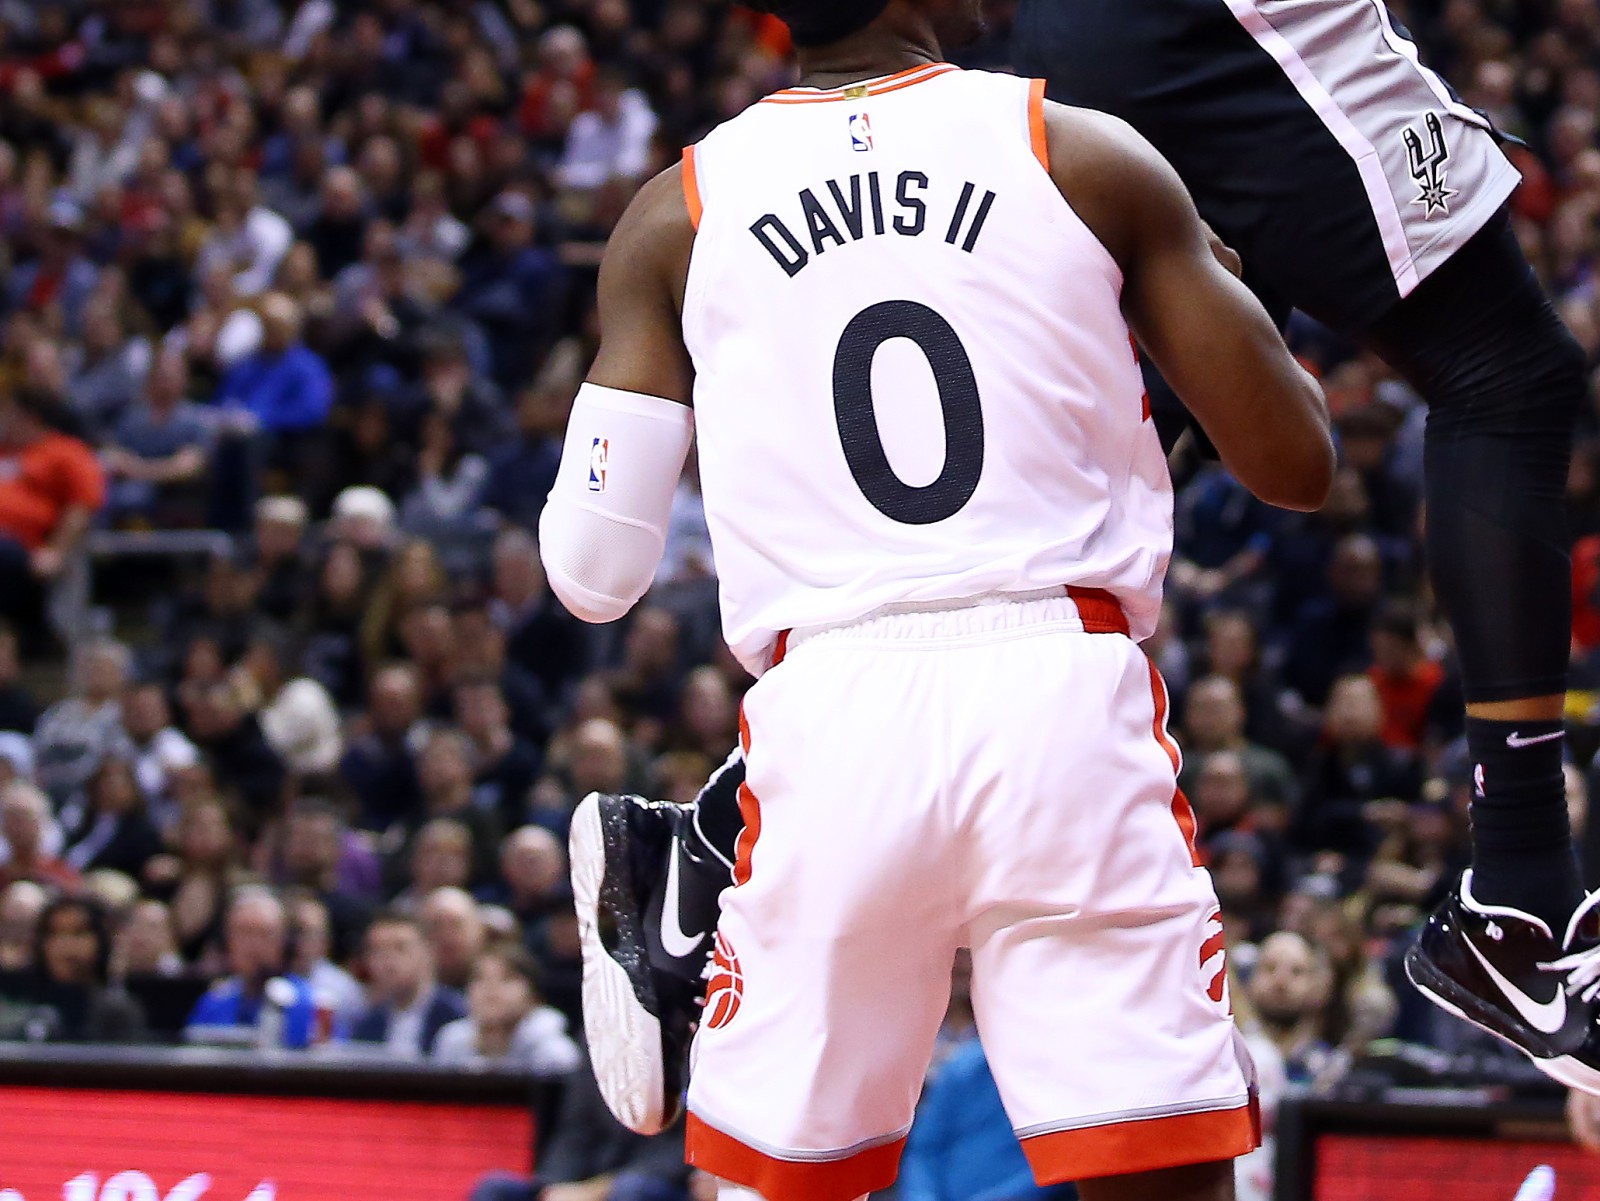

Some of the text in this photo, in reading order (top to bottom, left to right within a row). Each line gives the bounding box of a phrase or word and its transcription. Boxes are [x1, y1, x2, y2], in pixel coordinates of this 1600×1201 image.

[748, 170, 997, 278] DAVIS II
[832, 300, 985, 526] 0
